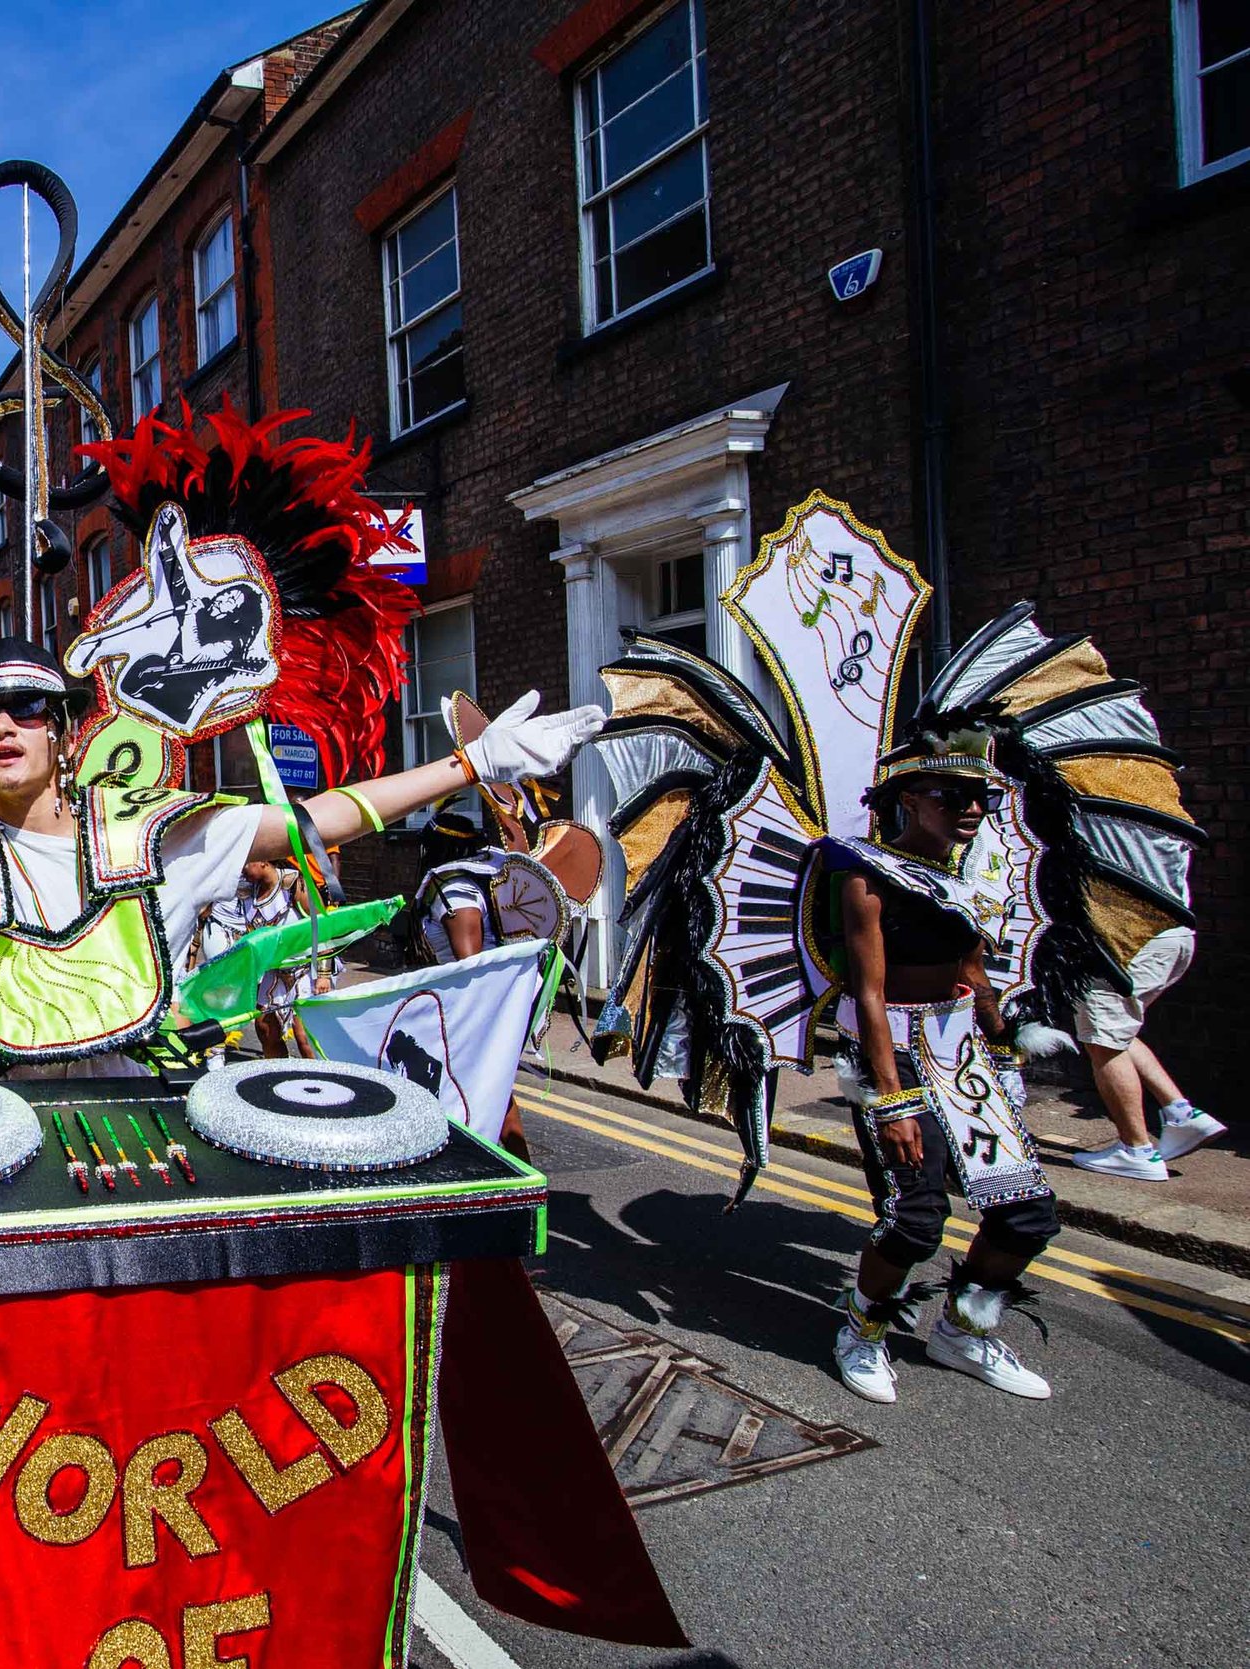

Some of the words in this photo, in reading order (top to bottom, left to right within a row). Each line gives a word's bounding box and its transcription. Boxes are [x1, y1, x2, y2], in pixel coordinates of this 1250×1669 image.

[274, 729, 291, 740] FOR
[284, 748, 315, 760] MARIGOLD
[292, 769, 303, 779] 617
[304, 770, 315, 780] 617
